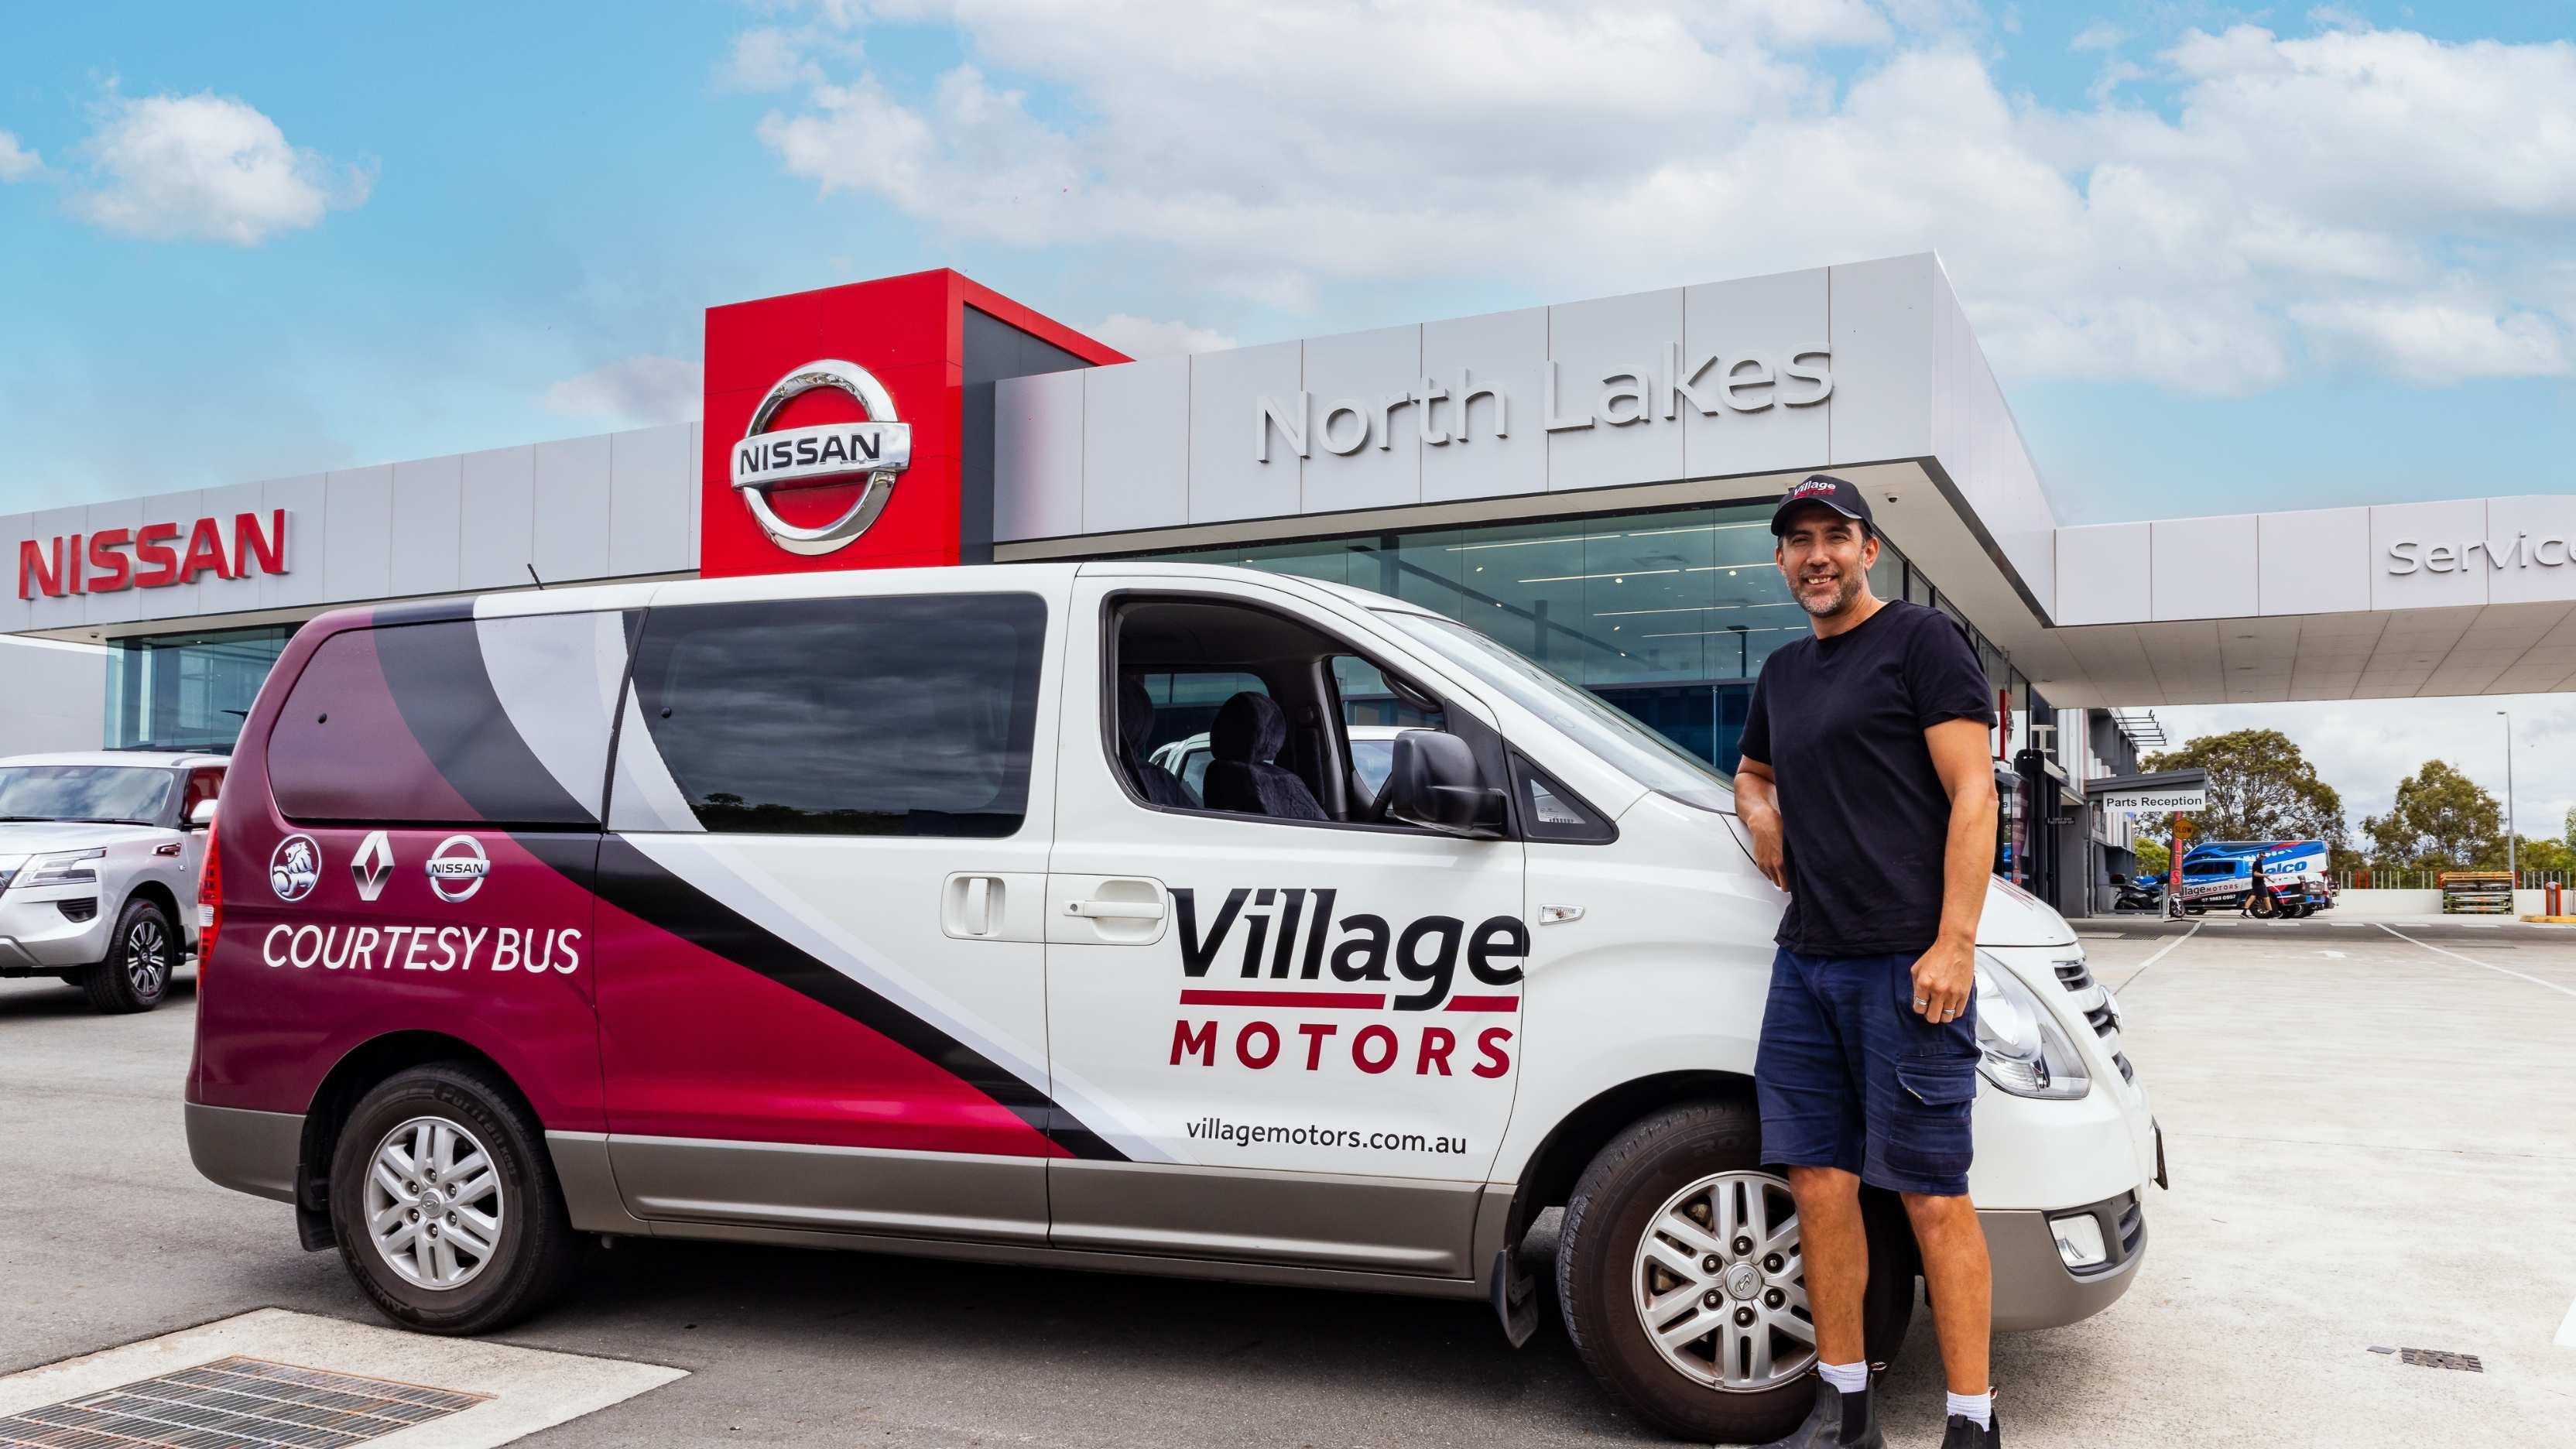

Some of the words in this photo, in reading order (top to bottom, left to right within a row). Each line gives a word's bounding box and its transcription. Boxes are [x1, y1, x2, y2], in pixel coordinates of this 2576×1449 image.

[1257, 367, 1508, 464] North
[1545, 341, 1833, 433] Lakes
[740, 432, 882, 475] NISSAN
[1794, 480, 1836, 496] Village
[19, 508, 291, 601] NISSAN
[2106, 797, 2137, 807] Parts
[2141, 796, 2202, 808] Reception
[431, 863, 484, 875] NISSAN
[2206, 883, 2239, 893] MOTORS
[263, 924, 488, 971] COURTESY
[491, 928, 582, 975] BUS
[1166, 888, 1531, 1012] Village
[1170, 1019, 1514, 1079] MOTORS
[1187, 1118, 1467, 1155] villagemotors.com.au
